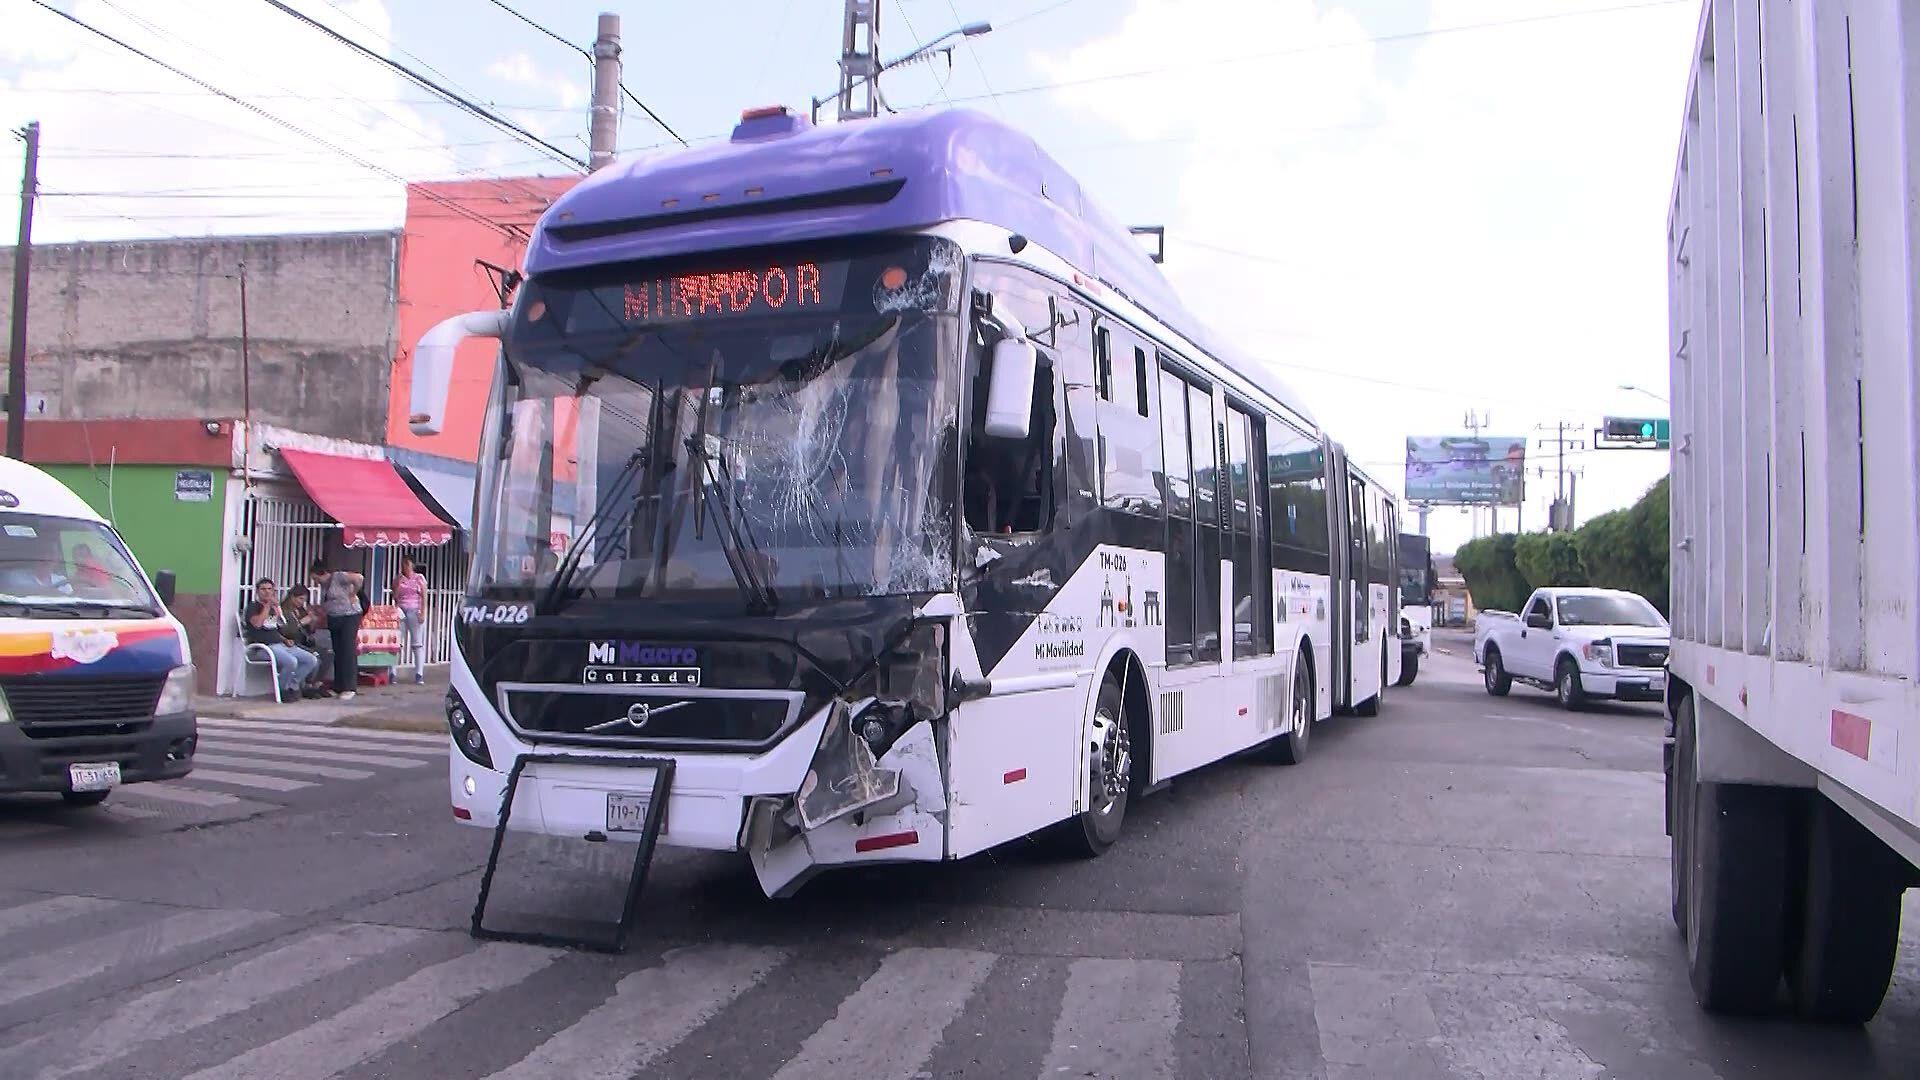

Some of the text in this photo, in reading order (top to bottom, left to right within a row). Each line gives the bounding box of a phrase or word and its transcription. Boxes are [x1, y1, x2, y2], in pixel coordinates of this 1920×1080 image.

[624, 263, 820, 320] MIRADOR
[1100, 552, 1127, 572] TM-026
[463, 605, 529, 625] TM-026
[588, 640, 697, 665] Mi Macro
[1035, 640, 1084, 660] Mi Movilidad
[587, 671, 696, 682] Calzada
